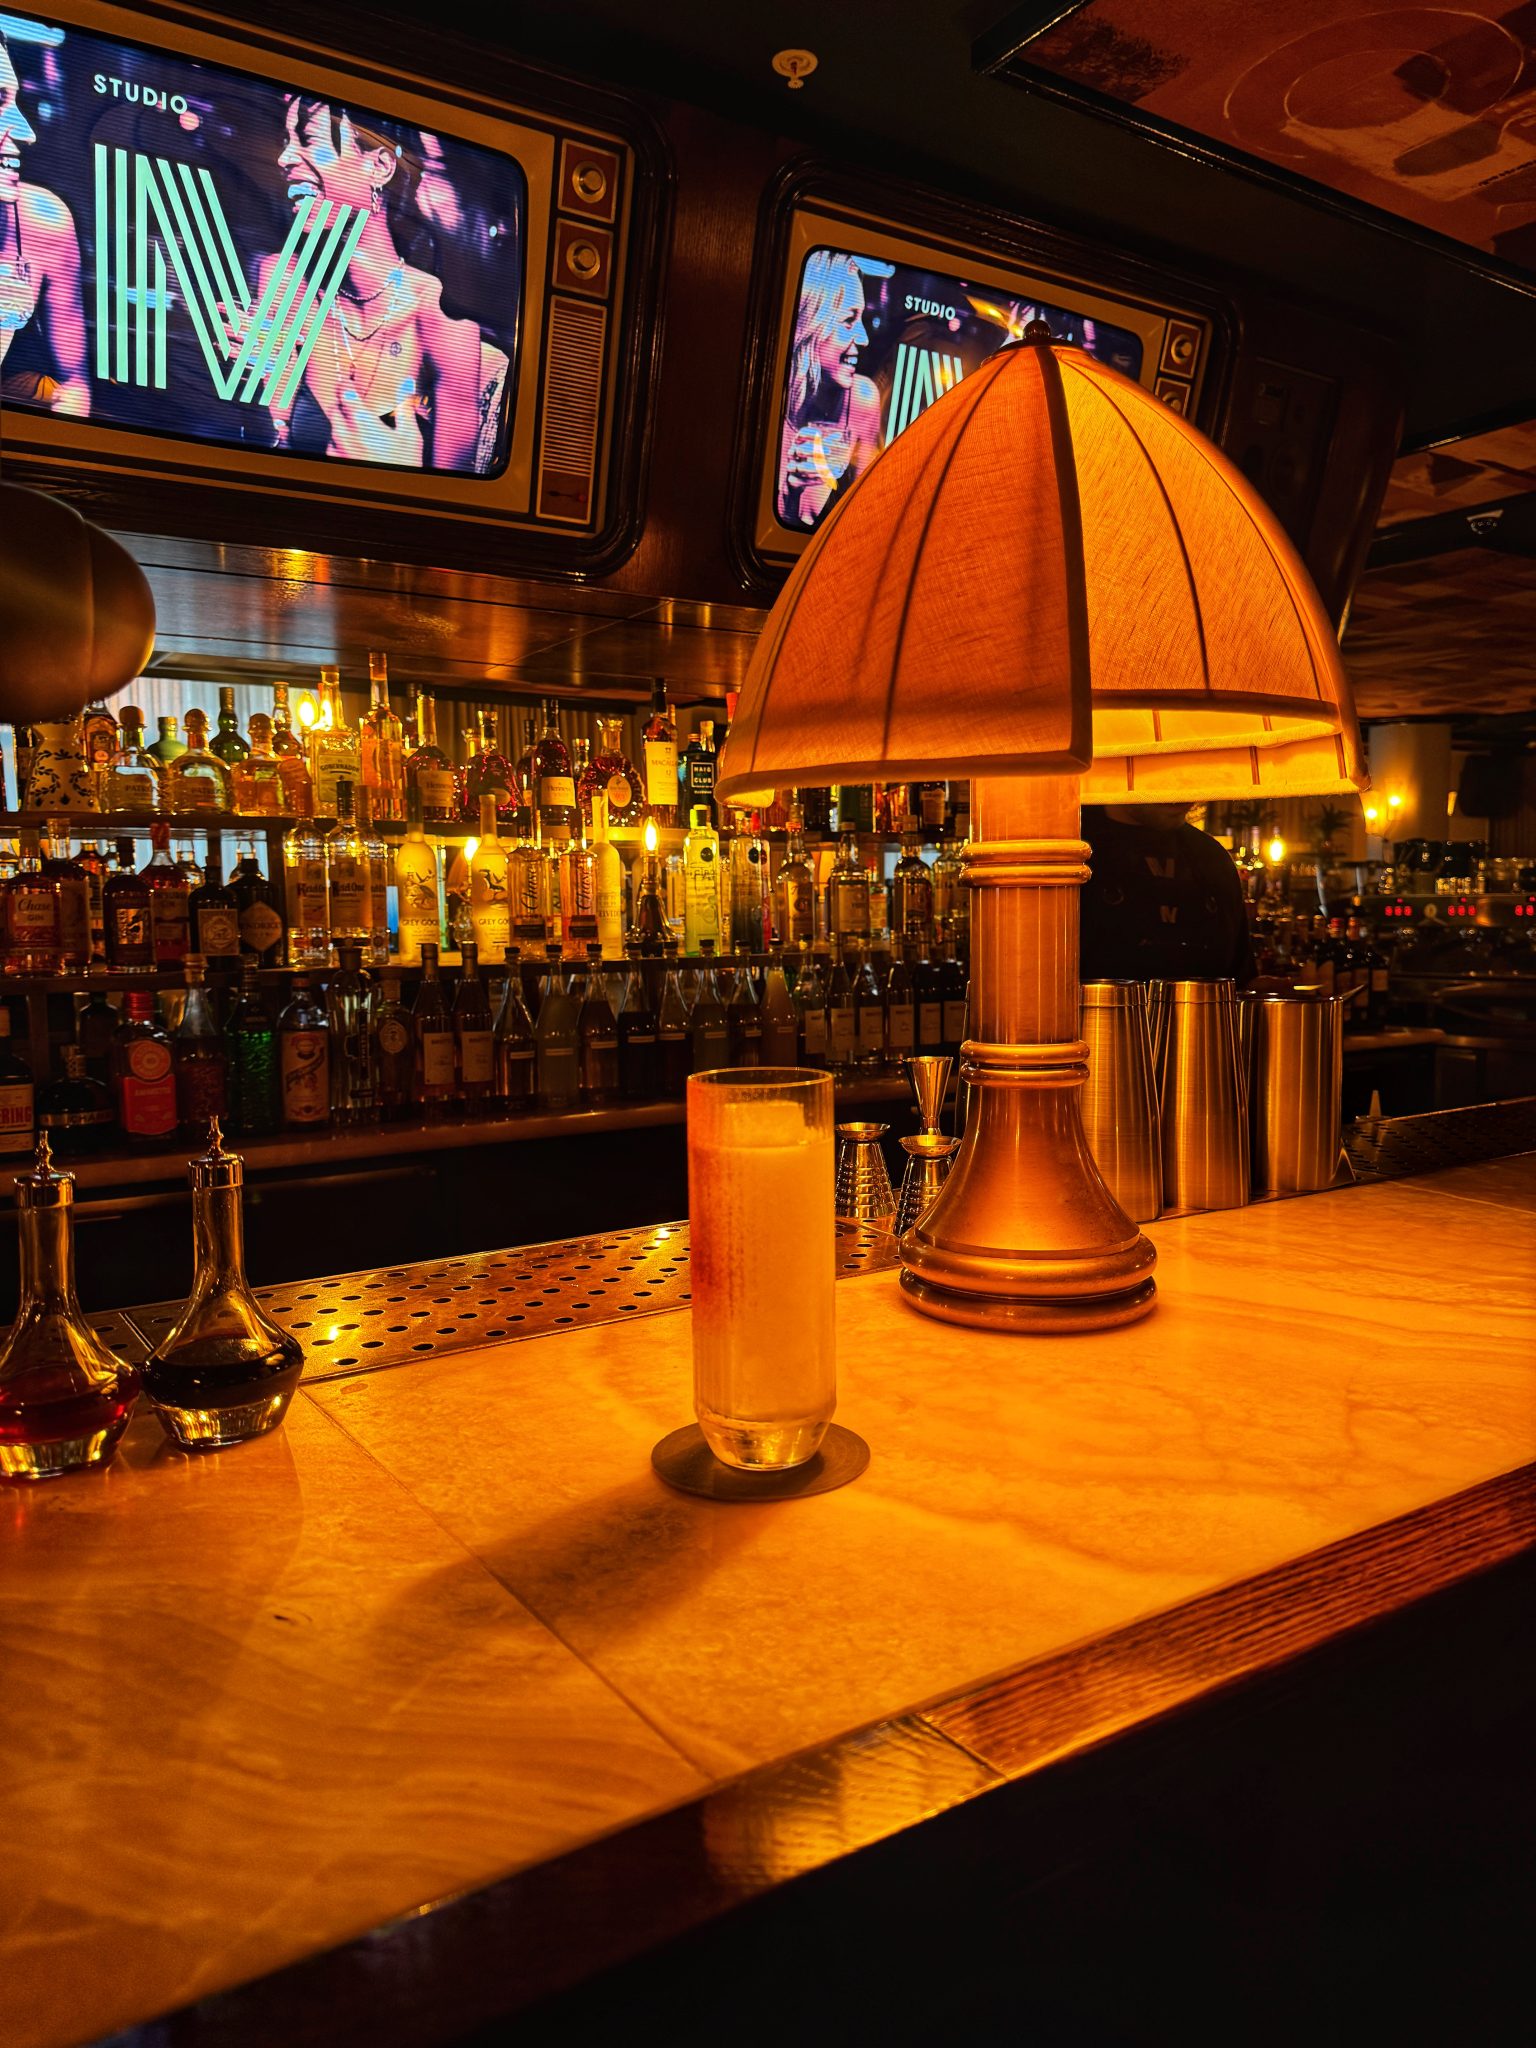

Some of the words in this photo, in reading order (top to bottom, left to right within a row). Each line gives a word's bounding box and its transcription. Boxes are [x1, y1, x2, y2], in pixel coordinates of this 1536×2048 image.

[93, 73, 188, 115] STUDIO
[904, 294, 956, 321] STUDIO
[18, 898, 50, 911] Chase
